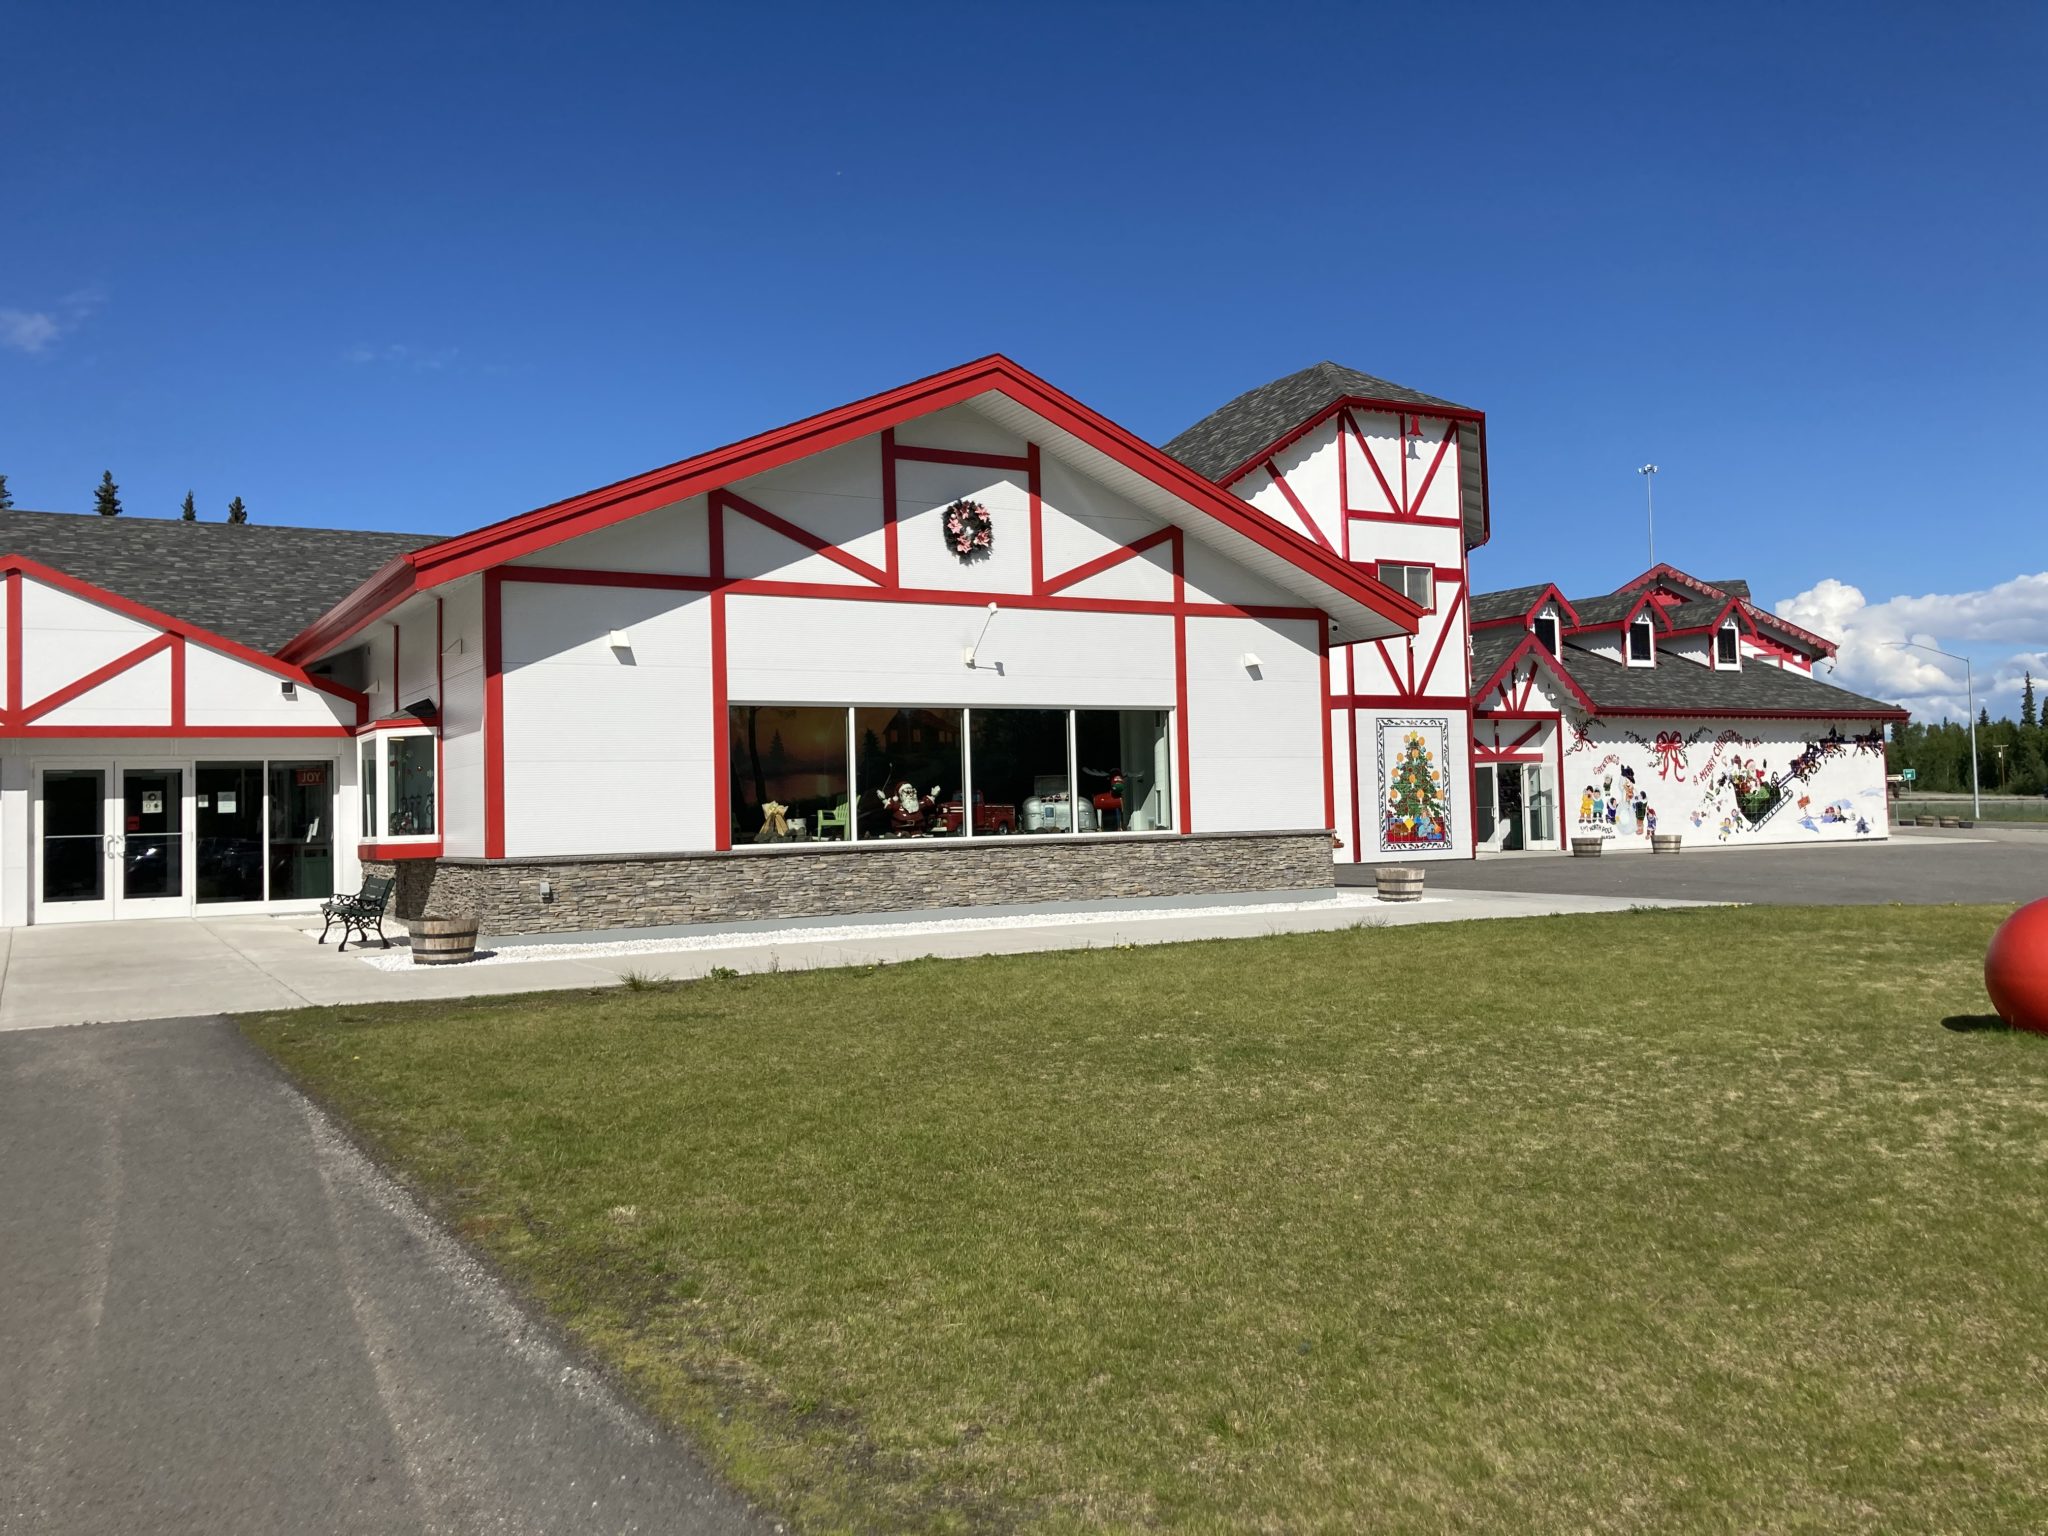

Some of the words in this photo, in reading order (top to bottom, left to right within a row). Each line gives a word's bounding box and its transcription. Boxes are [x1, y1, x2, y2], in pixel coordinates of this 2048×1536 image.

[1593, 754, 1620, 776] GREETINGS
[1699, 755, 1717, 782] MERRY
[1713, 729, 1743, 757] CHRISTMAS
[302, 772, 321, 783] JOY
